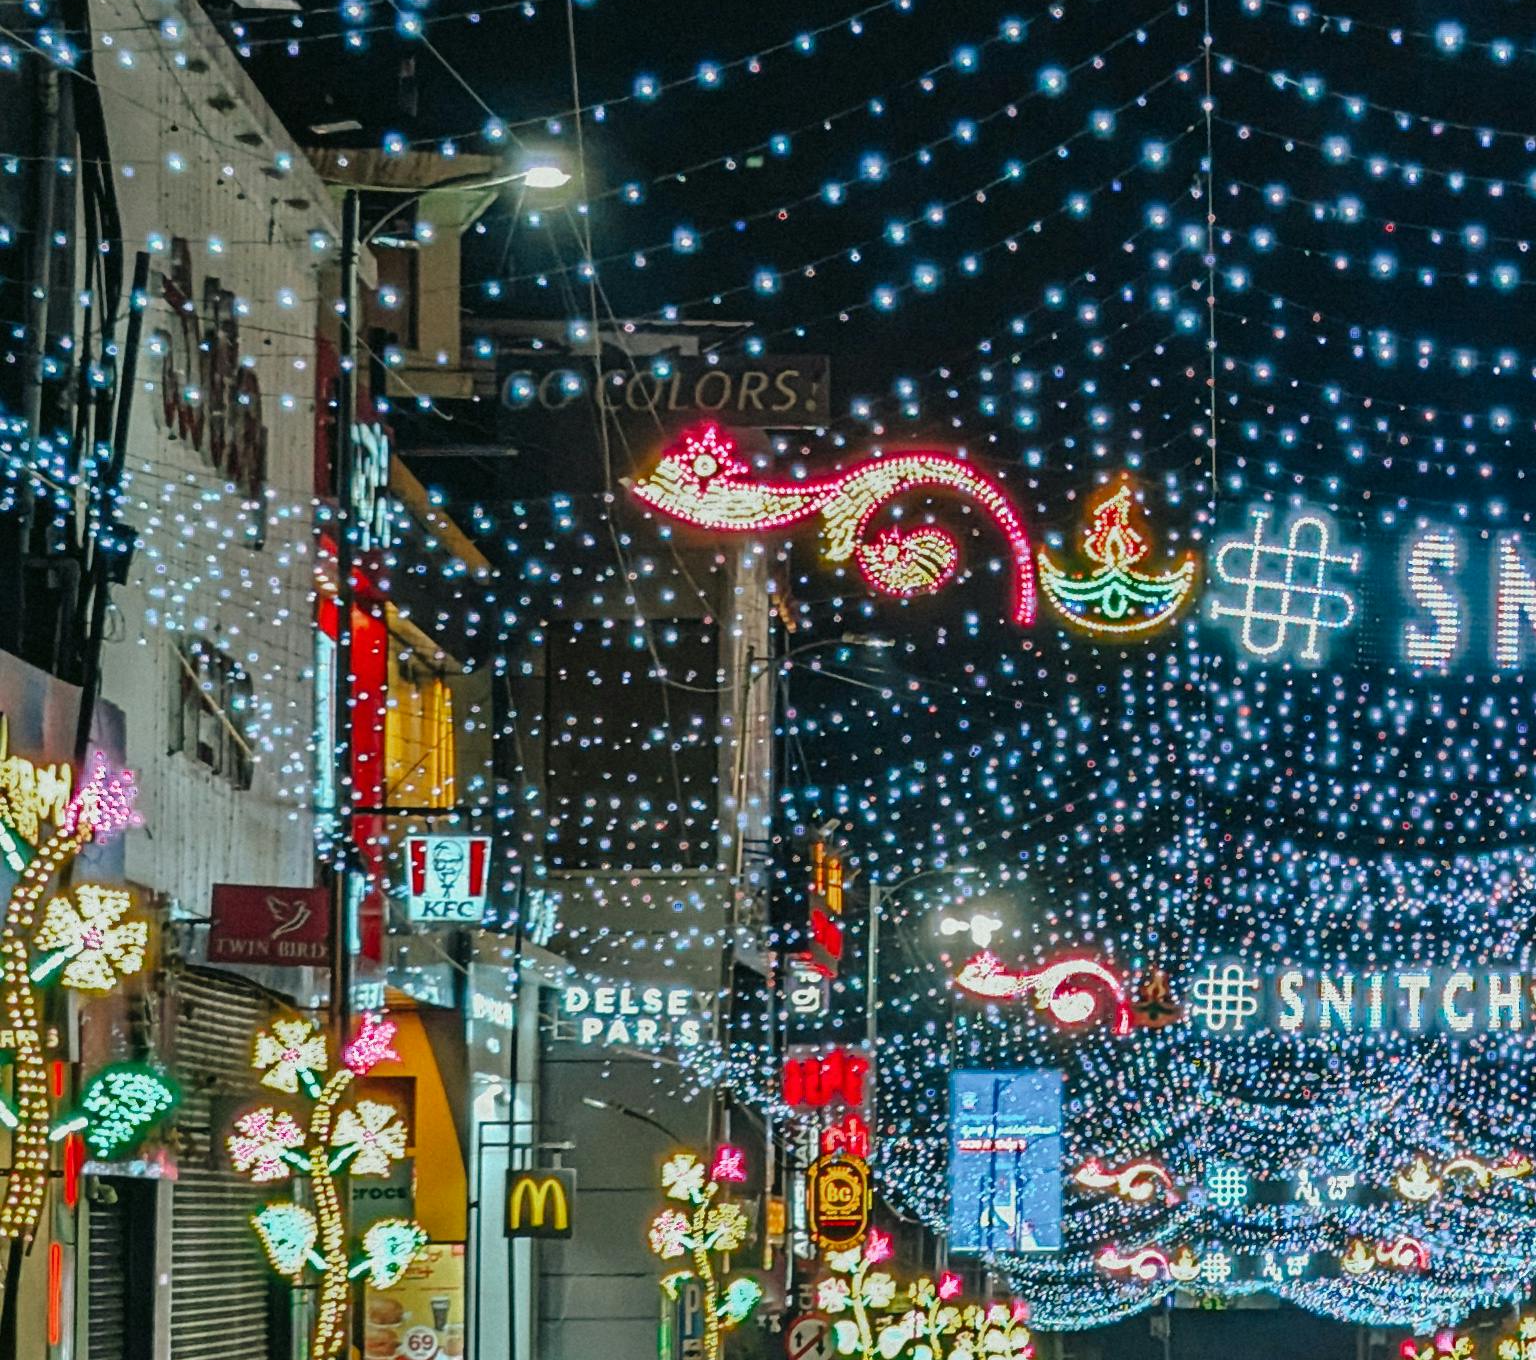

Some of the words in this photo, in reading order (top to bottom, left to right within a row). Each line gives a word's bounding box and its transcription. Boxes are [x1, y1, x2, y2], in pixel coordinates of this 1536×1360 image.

[421, 900, 475, 918] KFC
[214, 938, 271, 956] TWIN
[1278, 971, 1522, 1031] SNITCH
[408, 1333, 434, 1352] 69
